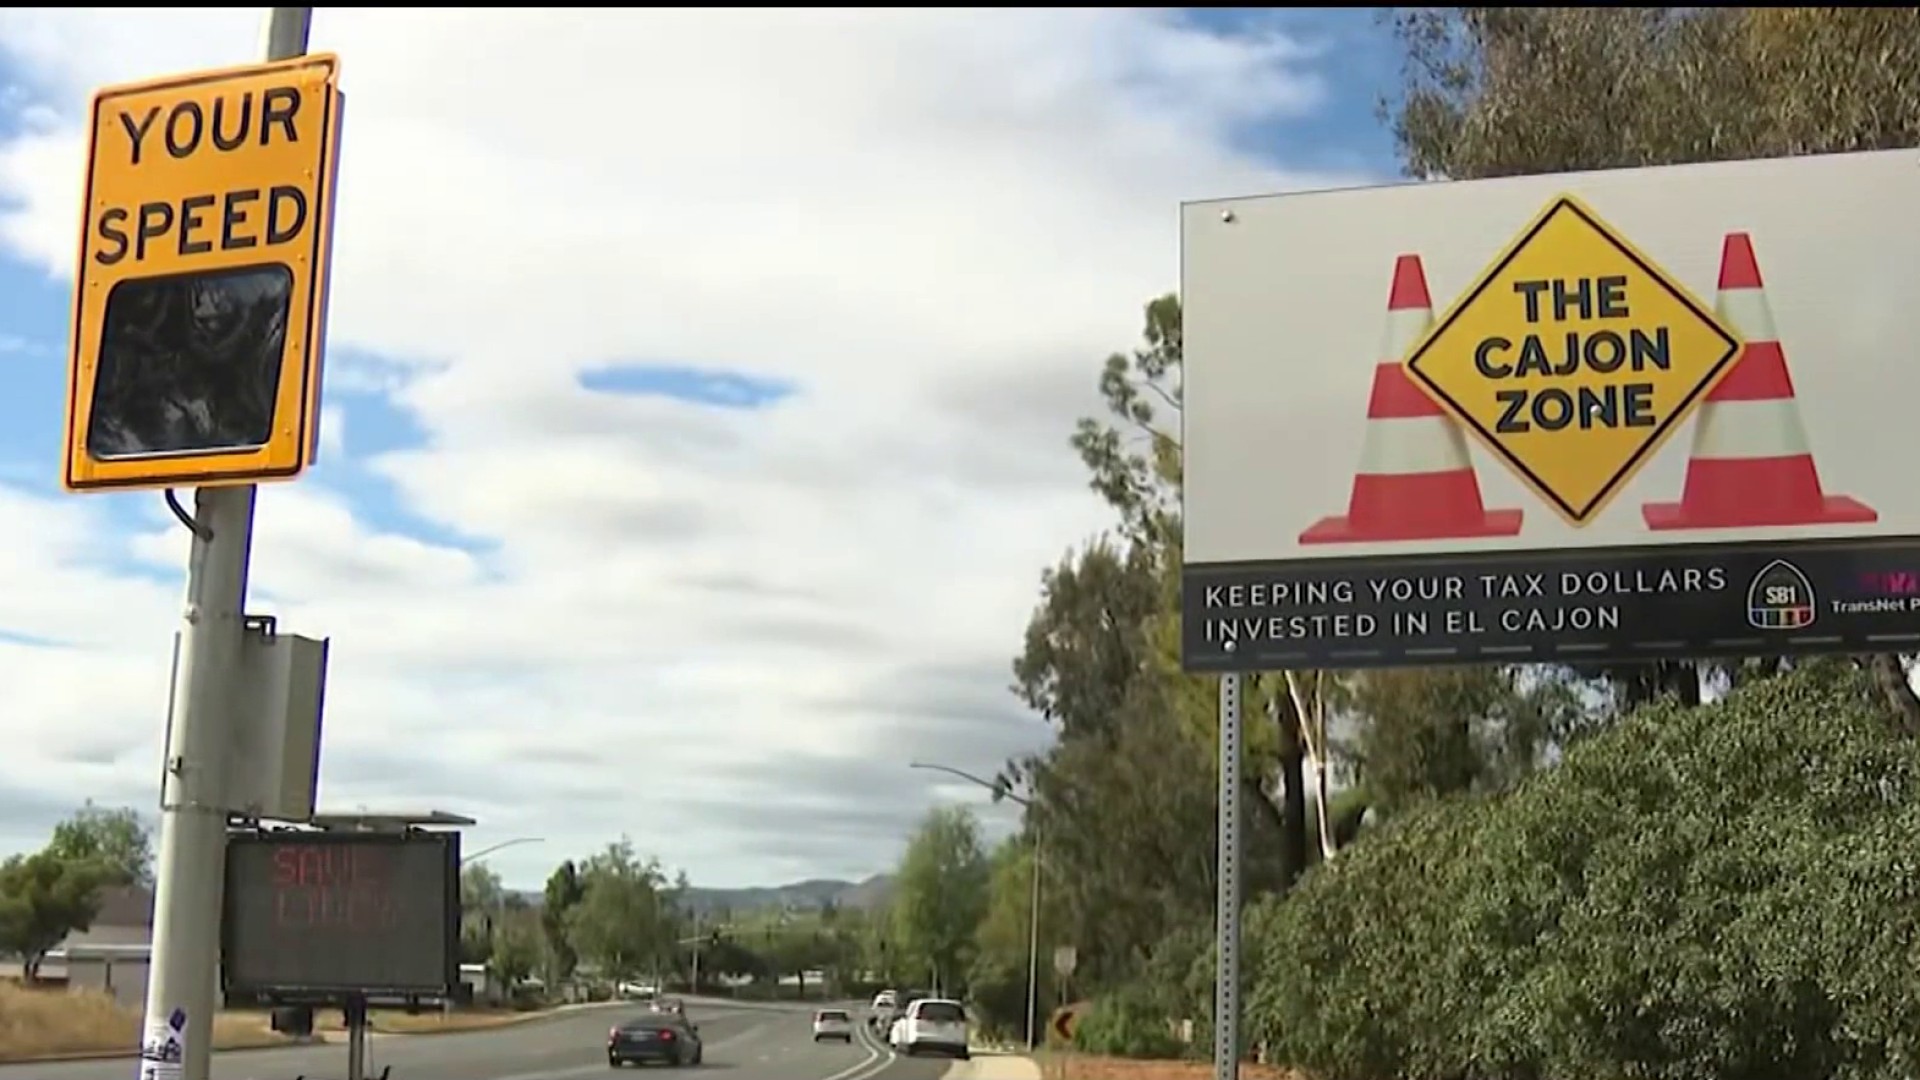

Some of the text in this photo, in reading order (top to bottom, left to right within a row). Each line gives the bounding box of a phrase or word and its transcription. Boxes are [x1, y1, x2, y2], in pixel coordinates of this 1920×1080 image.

[119, 86, 301, 165] YOUR
[95, 185, 308, 265] SPEED
[1513, 275, 1629, 323] THE
[1475, 326, 1671, 379] CAJON
[1496, 383, 1656, 434] ZONE
[1206, 567, 1727, 609] KEEPING YOUR TAX DOLLARS
[1765, 586, 1796, 604] SB1
[1831, 598, 1905, 613] TransNet
[1205, 605, 1620, 642] INVESTED IN EL CAJON
